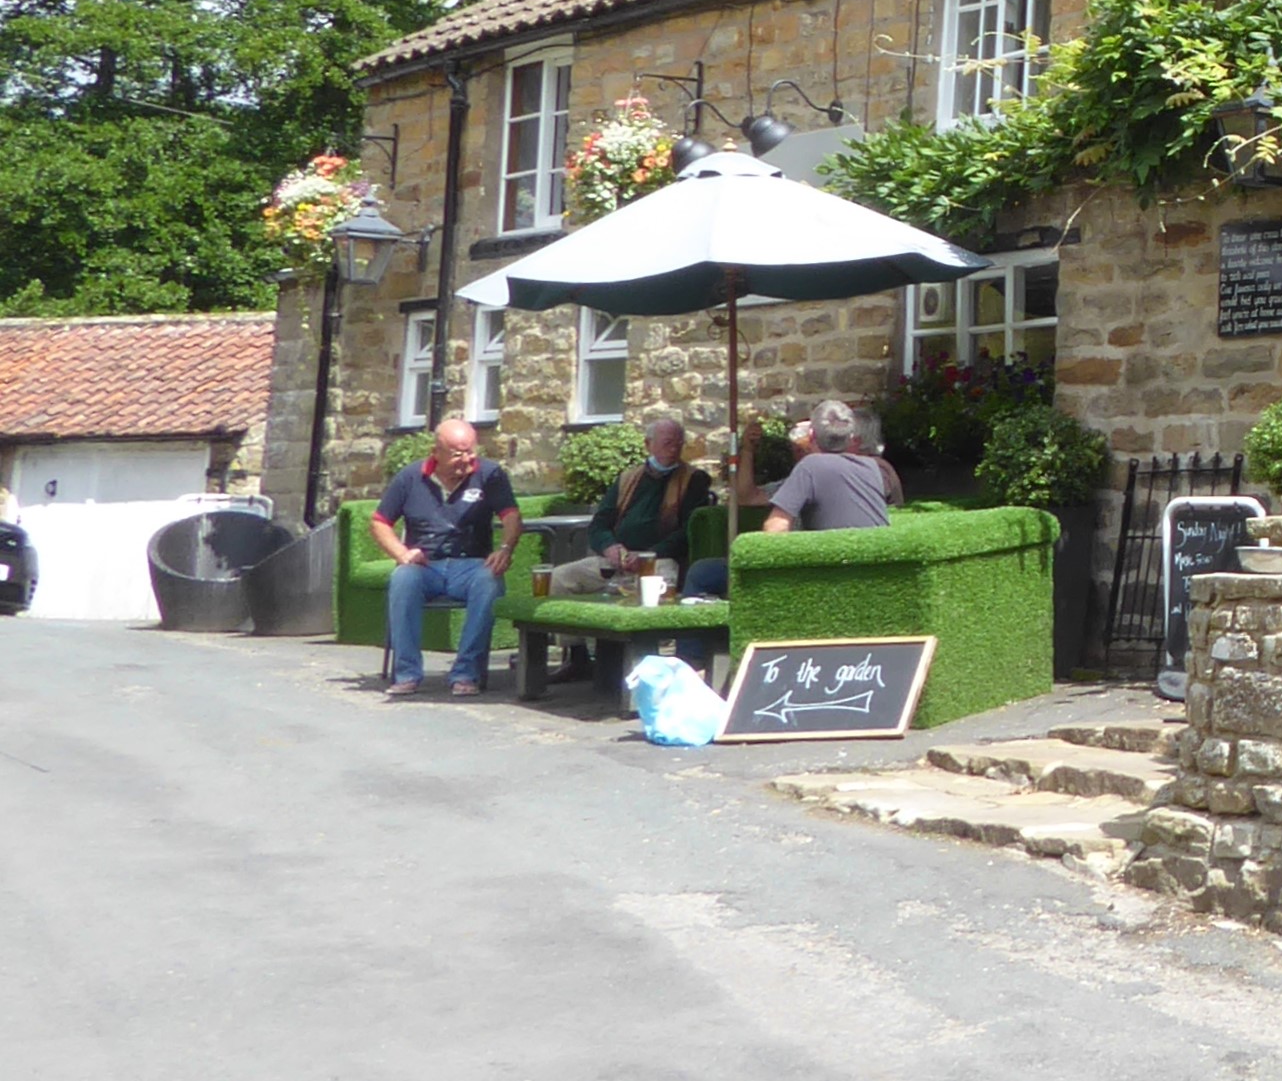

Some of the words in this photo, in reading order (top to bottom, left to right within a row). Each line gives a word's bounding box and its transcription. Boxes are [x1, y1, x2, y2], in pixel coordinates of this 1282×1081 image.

[1176, 521, 1207, 548] Sunday
[761, 654, 788, 683] To
[796, 657, 821, 689] the
[824, 653, 886, 694] garden
